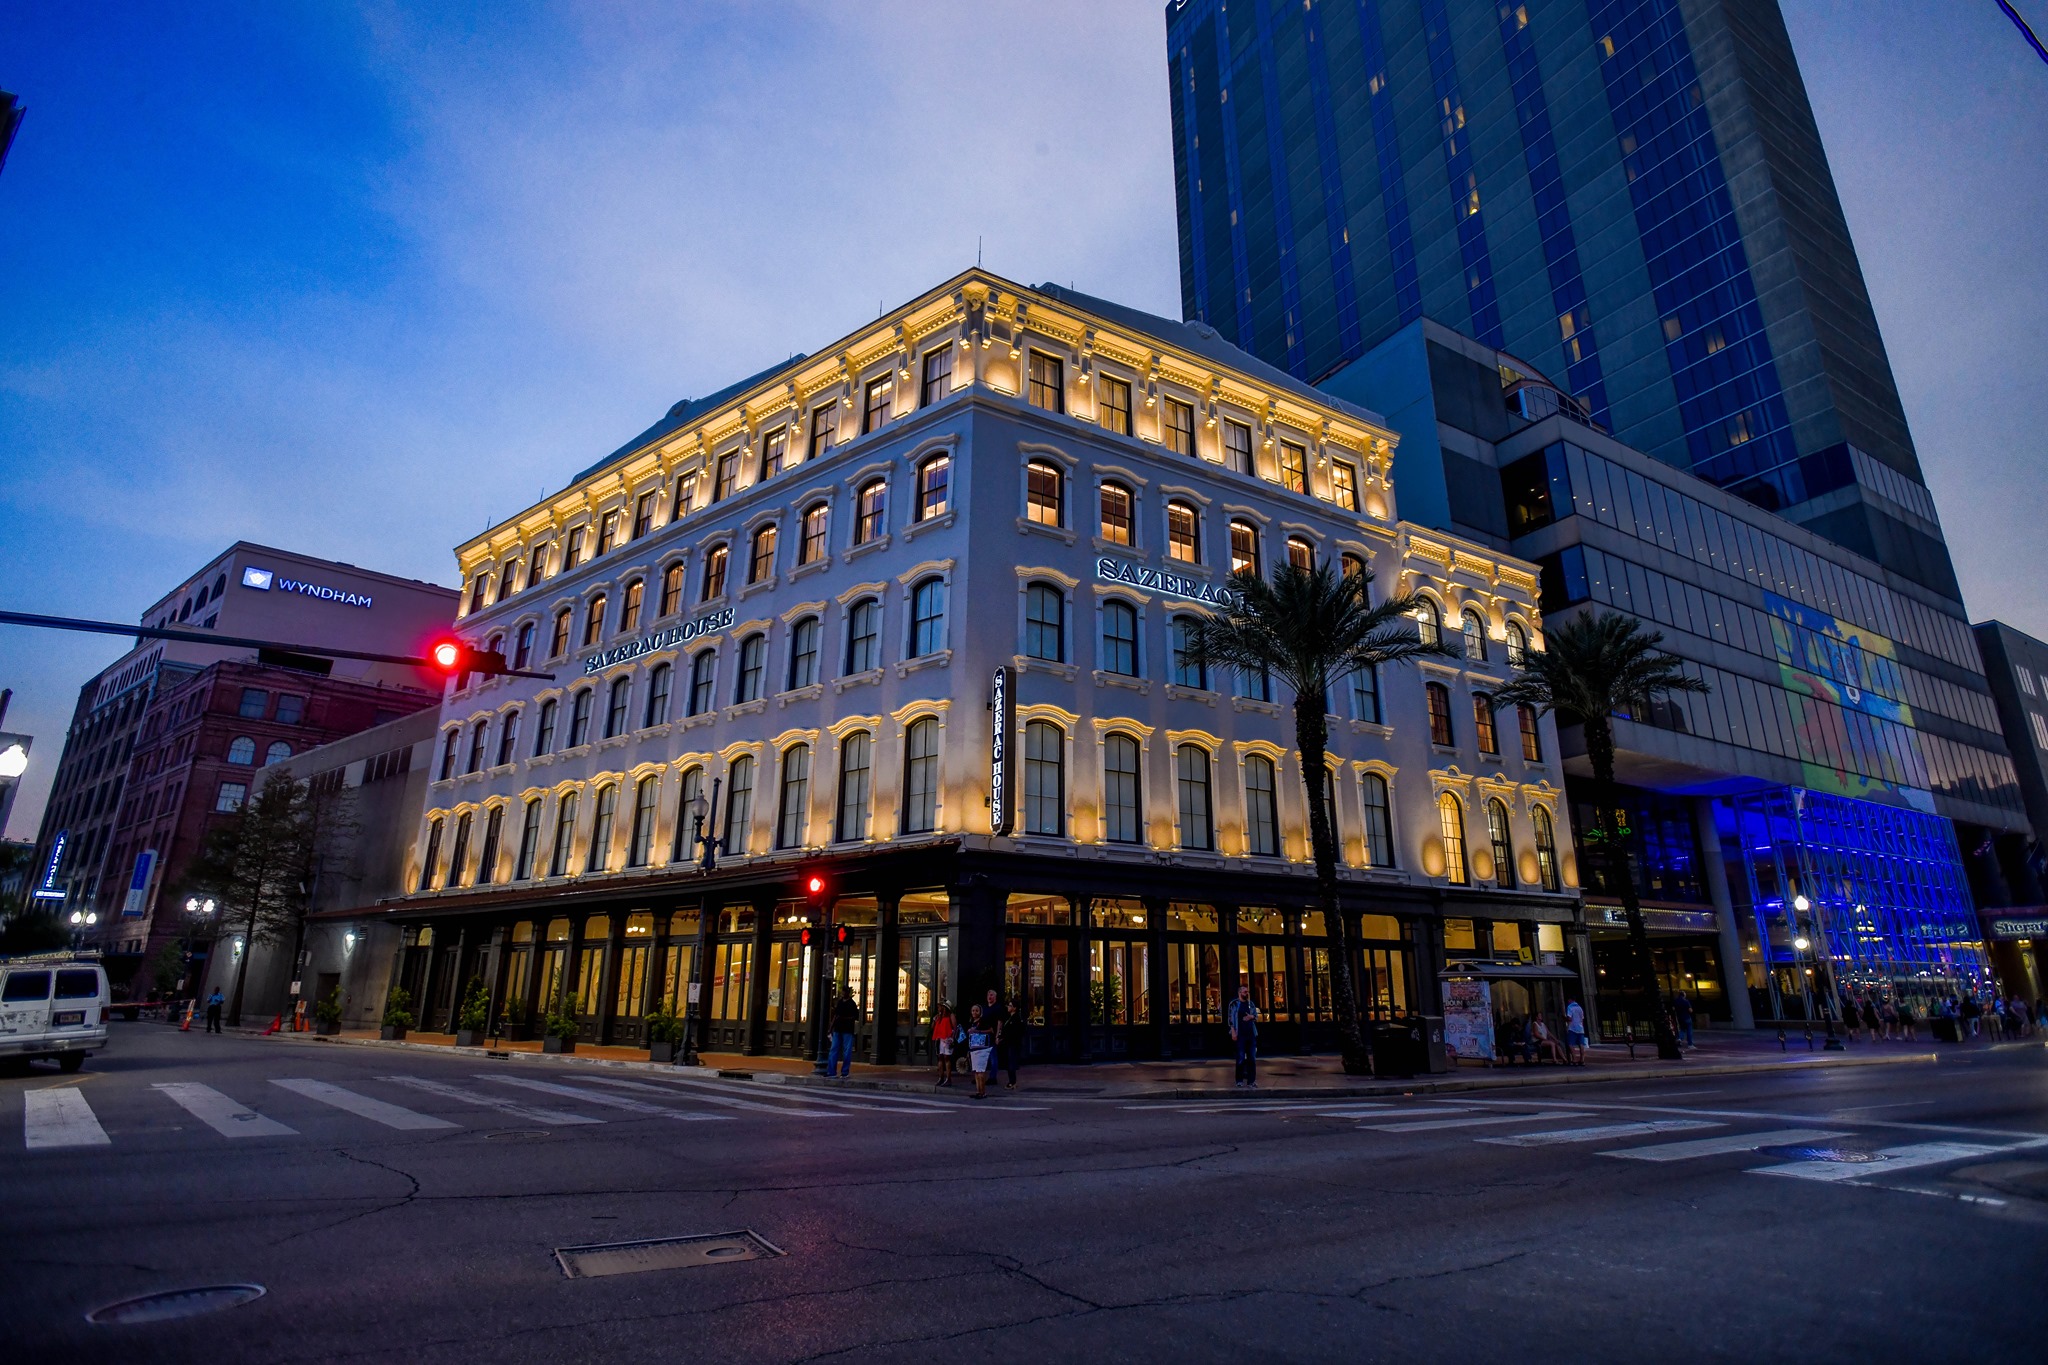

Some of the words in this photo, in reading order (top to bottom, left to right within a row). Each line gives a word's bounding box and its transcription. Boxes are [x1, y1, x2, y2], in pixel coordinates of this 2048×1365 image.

[279, 578, 372, 608] WYNDHAM
[1097, 557, 1233, 607] SAZERAC
[584, 632, 665, 674] SAZERAC
[665, 607, 735, 647] HOUSE
[993, 675, 1003, 759] SAZERAC
[992, 761, 1003, 825] HOUSE
